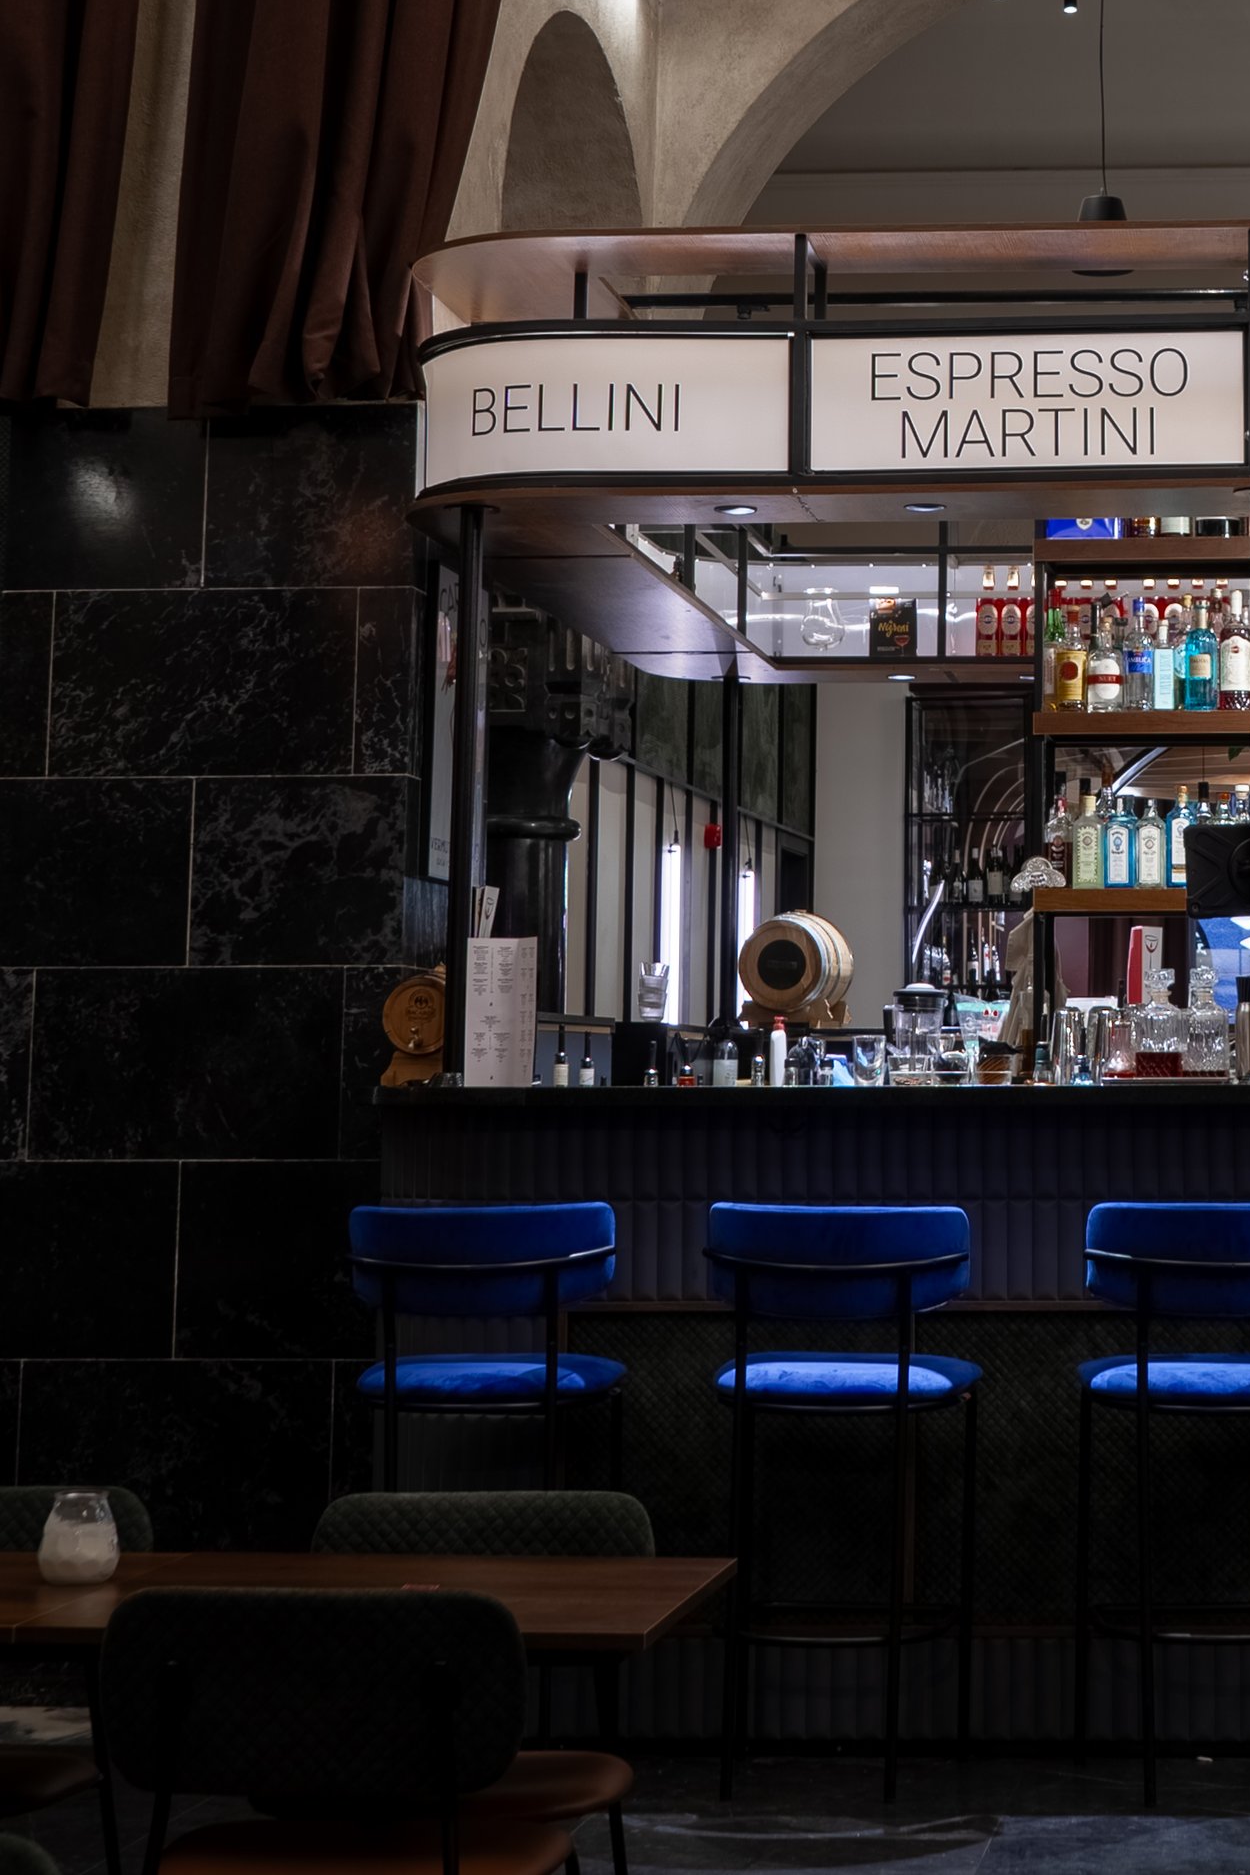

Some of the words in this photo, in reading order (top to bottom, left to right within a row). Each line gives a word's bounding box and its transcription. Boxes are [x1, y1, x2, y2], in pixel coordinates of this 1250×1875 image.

[870, 347, 1188, 401] ESPRESSO
[471, 383, 680, 437] BELLINI
[901, 406, 1155, 459] MARTINI
